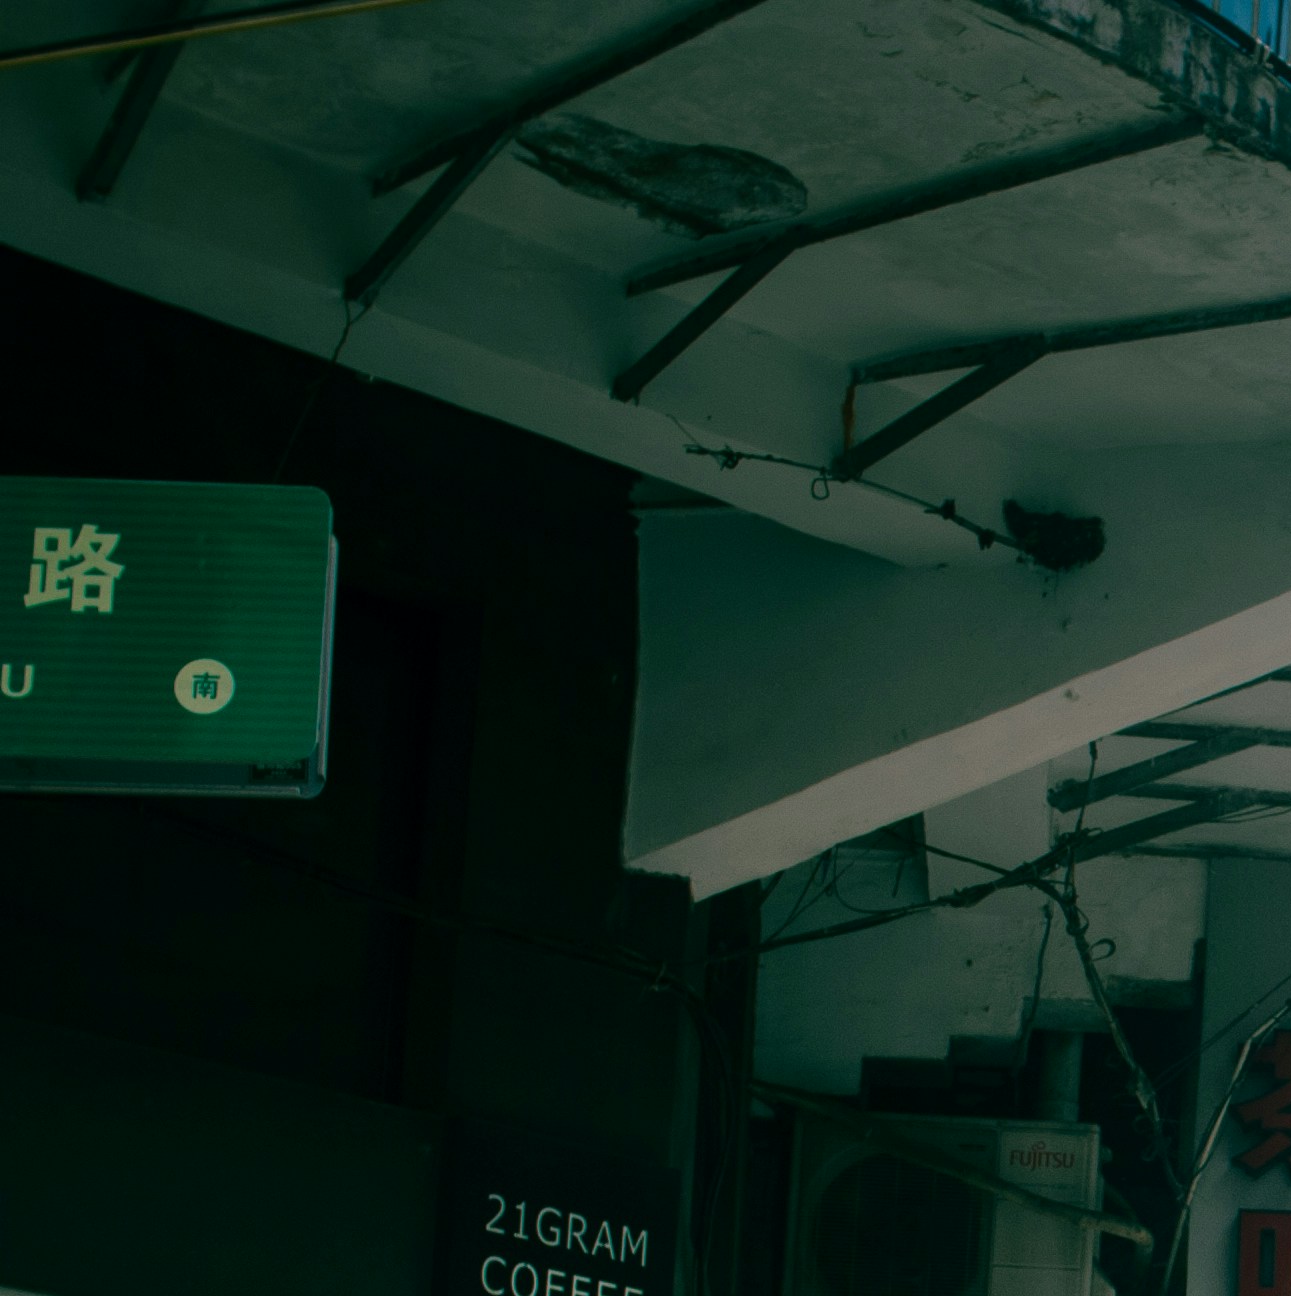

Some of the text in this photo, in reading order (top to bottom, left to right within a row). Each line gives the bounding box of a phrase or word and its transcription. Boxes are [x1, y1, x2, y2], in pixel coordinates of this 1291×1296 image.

[23, 523, 126, 614] 路
[192, 671, 222, 700] 南
[1009, 1141, 1076, 1171] FUJITSU
[486, 1193, 651, 1268] 21GRAM
